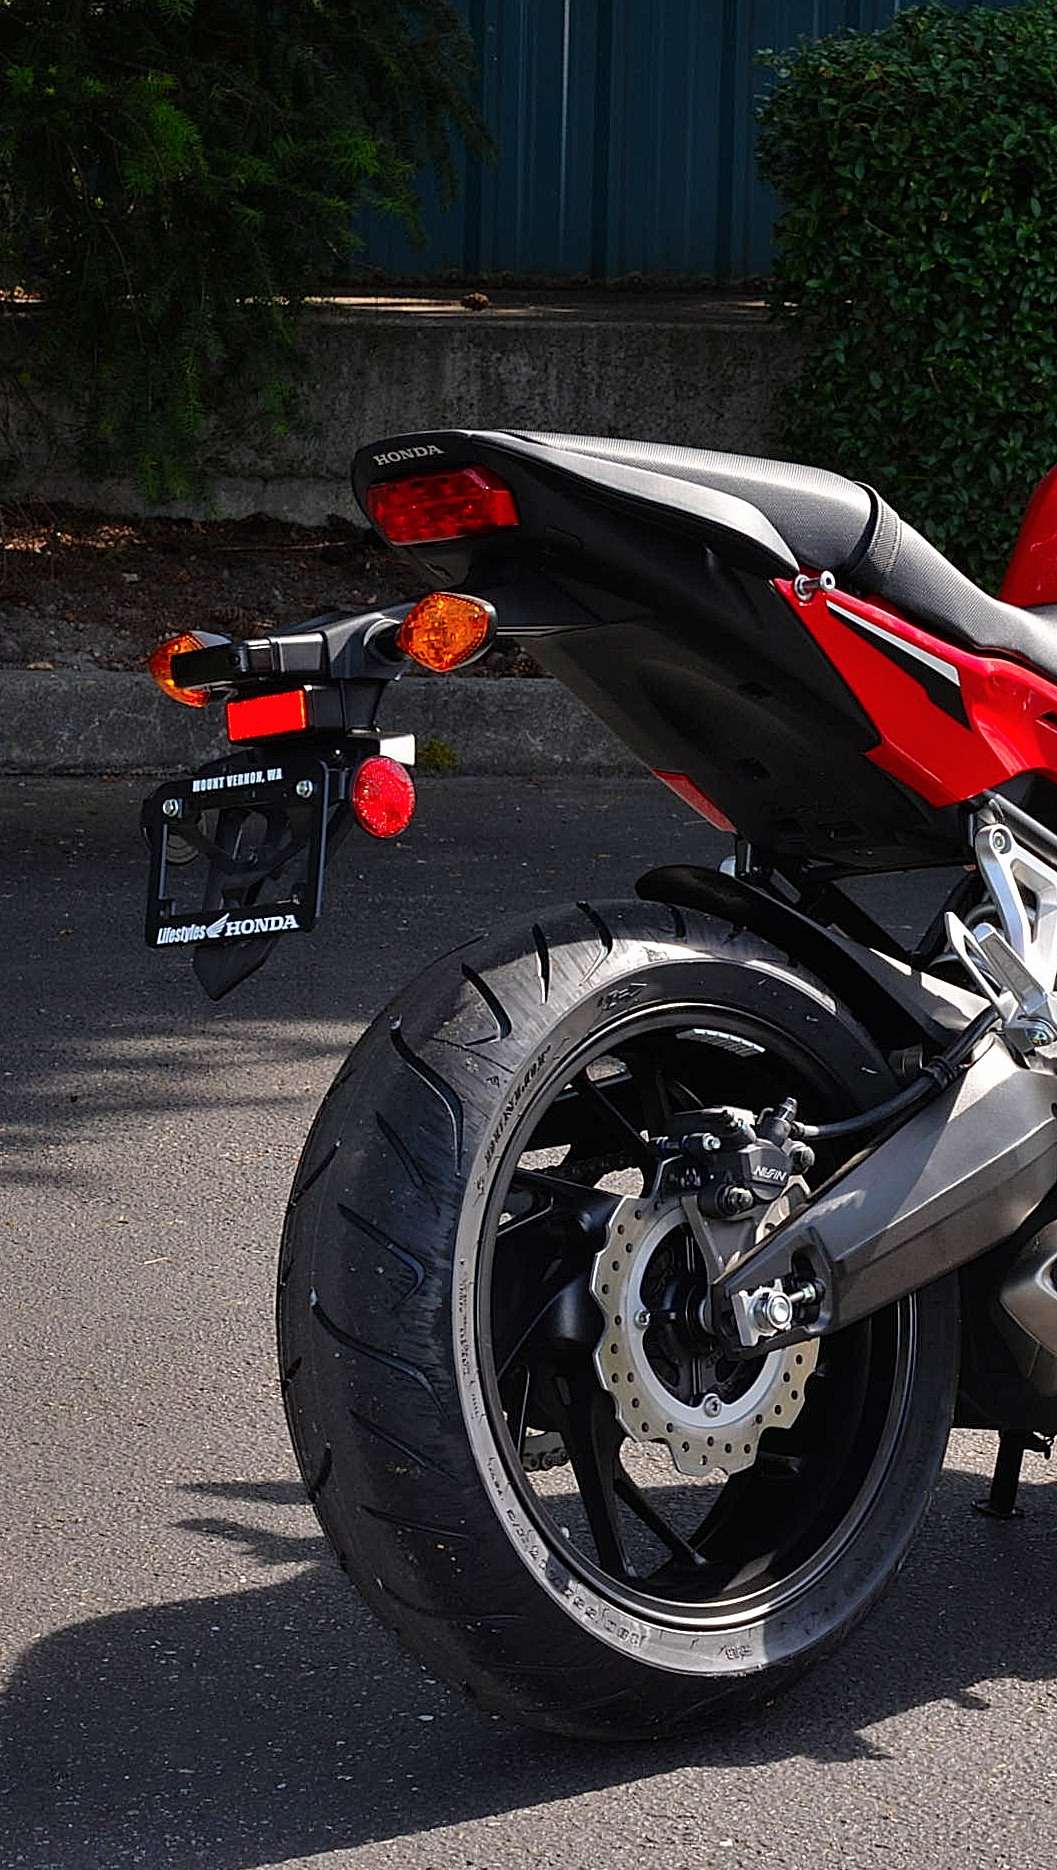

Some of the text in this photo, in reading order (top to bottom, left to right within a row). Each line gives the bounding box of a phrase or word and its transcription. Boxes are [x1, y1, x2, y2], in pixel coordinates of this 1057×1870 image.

[372, 445, 446, 466] HONDA
[192, 768, 283, 793] MOUNT VERNON, WA
[156, 914, 300, 945] Lifestyles HONDA
